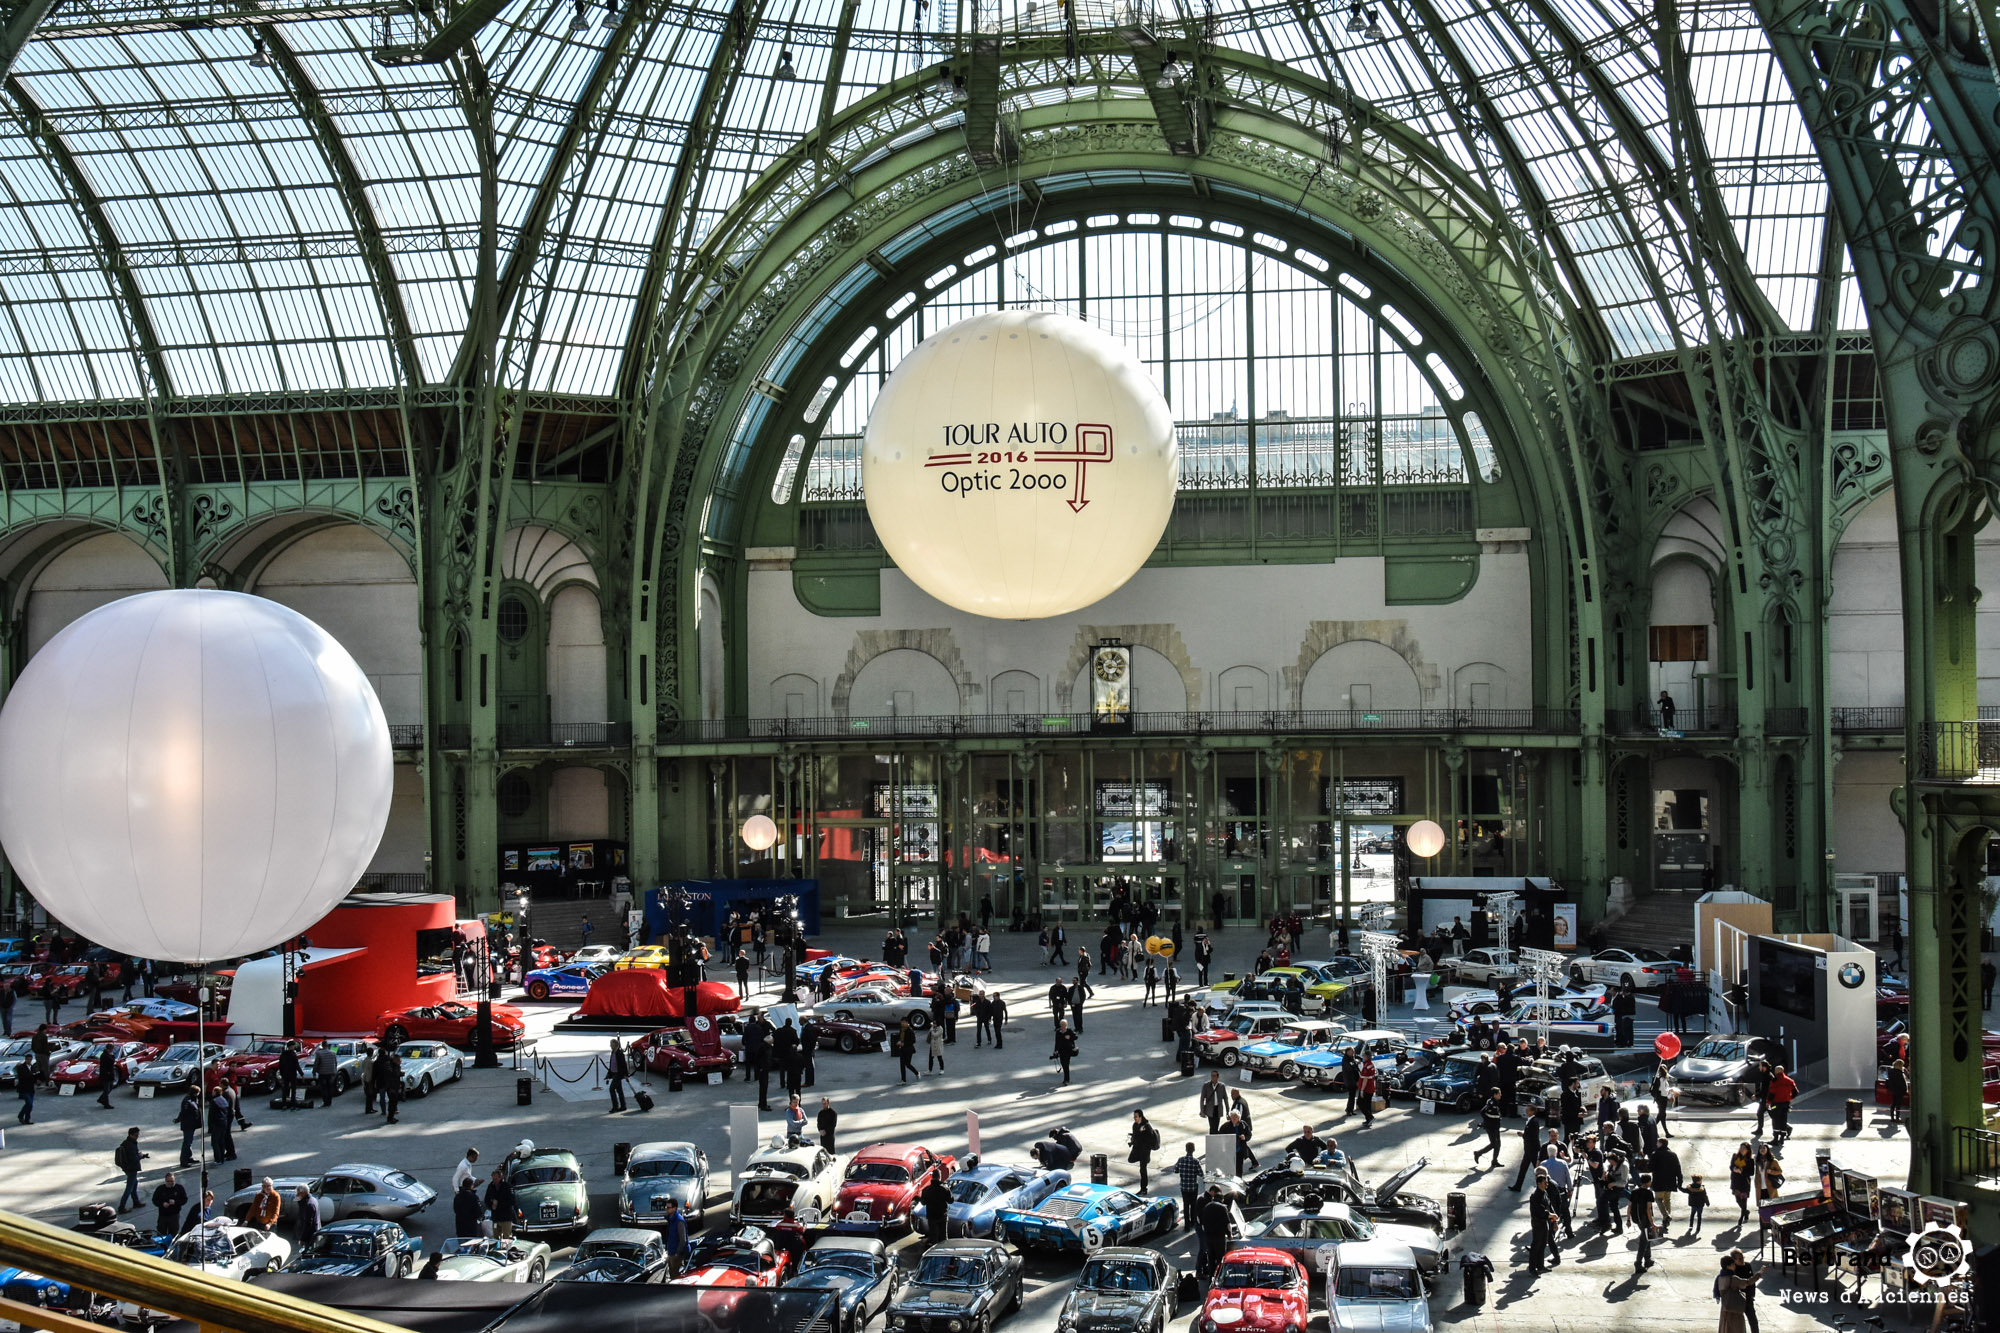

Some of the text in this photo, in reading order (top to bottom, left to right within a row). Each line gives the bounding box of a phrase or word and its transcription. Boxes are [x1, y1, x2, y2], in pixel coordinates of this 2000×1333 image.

[943, 422, 1068, 446] TOUR AUTO
[977, 451, 1029, 464] 2016
[941, 470, 1002, 498] Optic
[1087, 1228, 1099, 1246] 5
